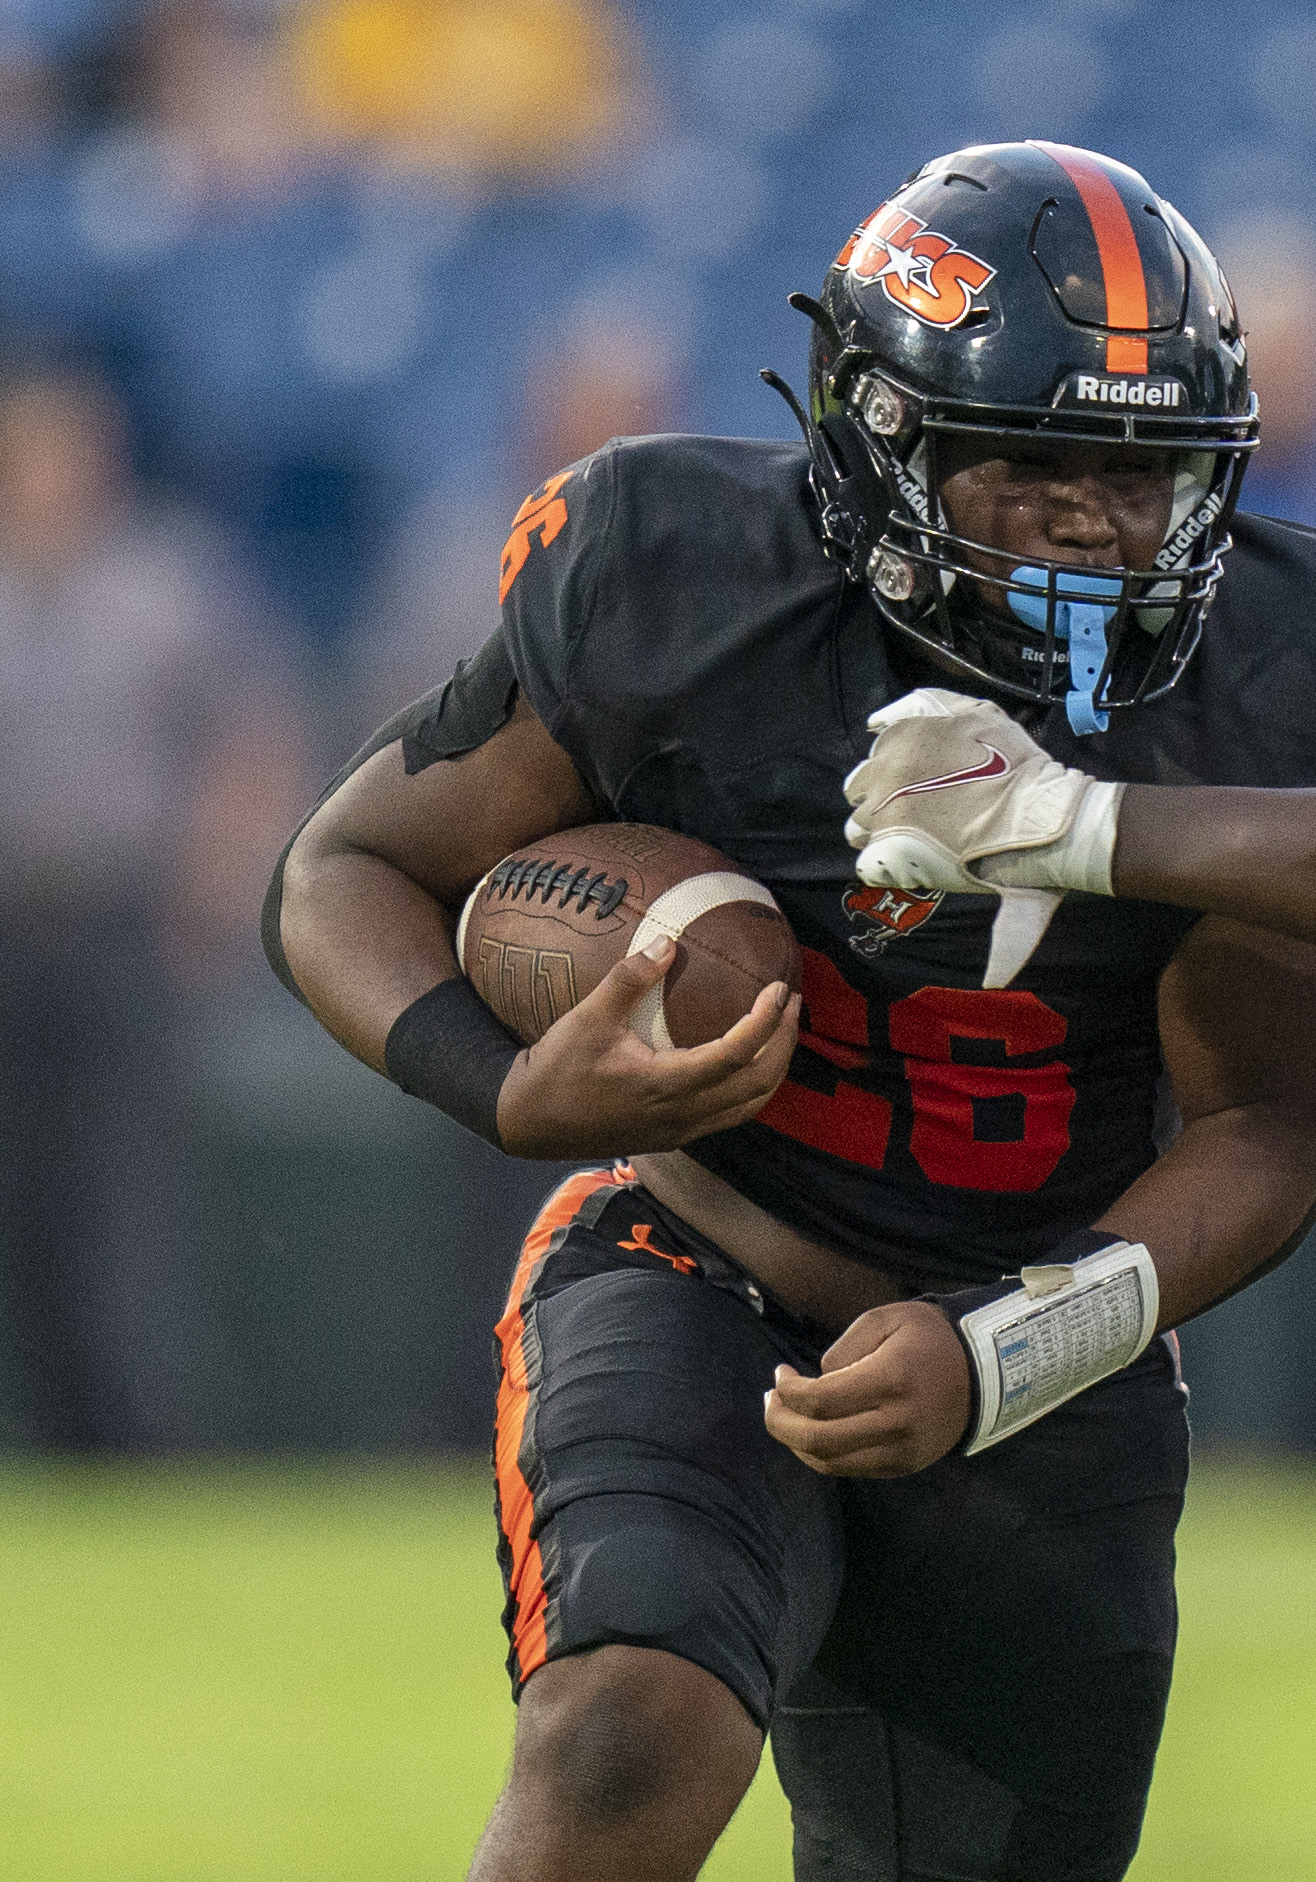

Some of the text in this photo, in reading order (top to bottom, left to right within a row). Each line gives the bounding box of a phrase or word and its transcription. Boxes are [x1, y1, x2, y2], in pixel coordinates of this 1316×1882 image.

[1077, 375, 1180, 407] Riddell
[1155, 493, 1222, 571] Riddell
[872, 891, 912, 923] H
[748, 944, 1076, 1192] 26
